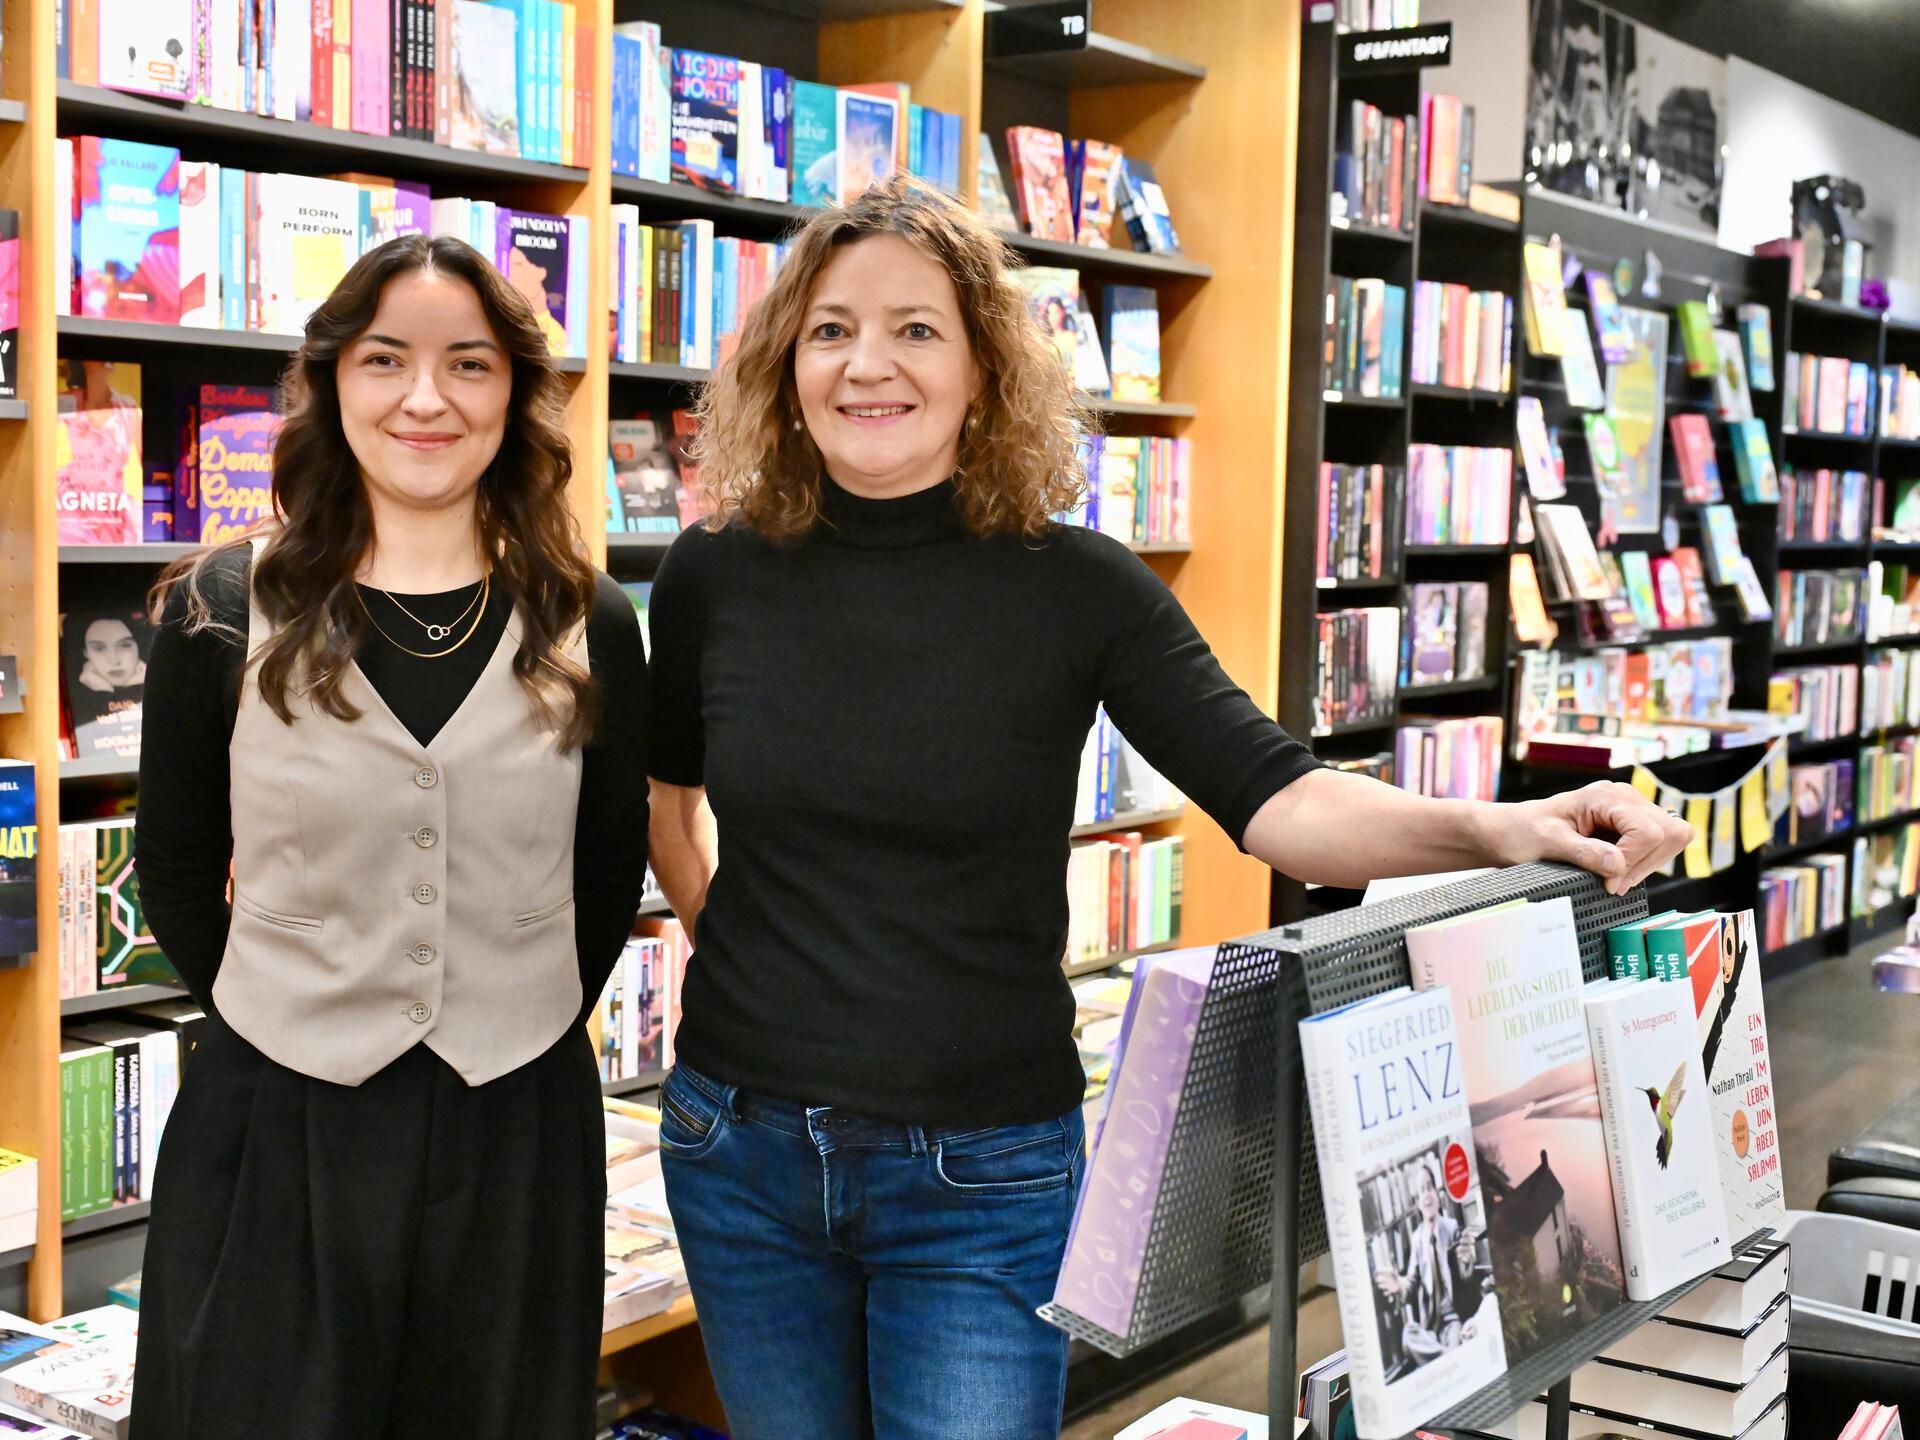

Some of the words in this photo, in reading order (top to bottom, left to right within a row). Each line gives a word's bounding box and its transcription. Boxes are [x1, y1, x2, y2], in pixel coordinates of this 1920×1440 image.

[1060, 15, 1085, 36] TB
[673, 51, 737, 81] VIGDIS
[298, 206, 340, 220] BORN
[283, 221, 354, 237] PERFORM
[200, 435, 275, 473] Demo
[1486, 955, 1512, 984] DIE
[1613, 955, 1626, 981] BEN
[1627, 954, 1641, 981] AMA
[1654, 954, 1667, 982] BEN
[1667, 953, 1681, 981] AMA
[1466, 967, 1575, 1021] LIEBLINGSORTE
[1346, 1003, 1451, 1062] SIEGFRIED
[1503, 1013, 1529, 1041] DER
[1529, 996, 1582, 1032] DICHTER
[1621, 1022, 1632, 1039] Sy
[1631, 1010, 1678, 1033] Montgomery
[1747, 1012, 1762, 1032] EIN
[1750, 1036, 1765, 1056] TAG
[1600, 1066, 1611, 1084] DES
[1712, 1076, 1735, 1097] Nathan
[1735, 1067, 1755, 1090] Thrall
[1755, 1060, 1767, 1078] IM
[1353, 1041, 1461, 1131] LENZ
[1746, 1083, 1770, 1108] LEBEN
[1604, 1085, 1618, 1132] GESCHENK
[1756, 1107, 1772, 1128] VON
[1610, 1132, 1620, 1151] DAS
[1756, 1130, 1775, 1153] ABED
[1747, 1154, 1778, 1183] SALAMA
[1614, 1154, 1629, 1215] MONTGOMERY
[1654, 1201, 1667, 1215] DAS
[1667, 1189, 1699, 1208] GESCHENK
[1666, 1211, 1679, 1224] DES
[1679, 1198, 1706, 1217] KOLIBRIS
[1333, 1193, 1353, 1253] LENZ
[1341, 1261, 1371, 1384] SIEGFRIED
